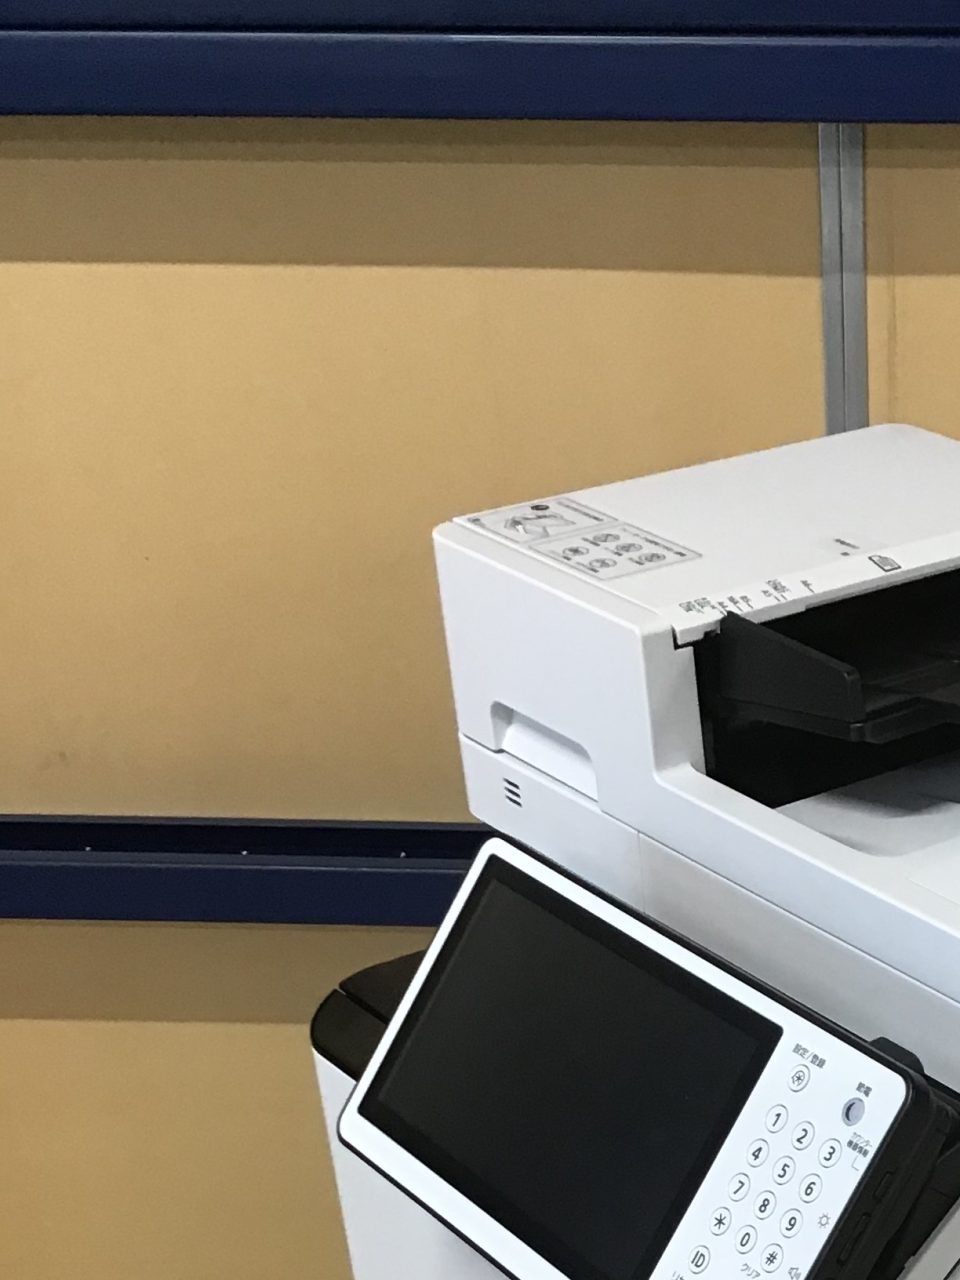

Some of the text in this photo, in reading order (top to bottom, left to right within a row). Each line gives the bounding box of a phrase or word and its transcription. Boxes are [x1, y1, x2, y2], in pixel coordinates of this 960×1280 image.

[772, 1112, 782, 1127] 1
[796, 1128, 808, 1144] 2
[752, 1146, 763, 1161] 4
[823, 1145, 836, 1161] 3
[777, 1163, 790, 1179] 5
[733, 1180, 745, 1195] 7
[804, 1181, 817, 1197] 6
[758, 1198, 770, 1213] 8
[785, 1216, 797, 1232] 9
[691, 1250, 706, 1268] ID
[739, 1263, 761, 1279] クリア
